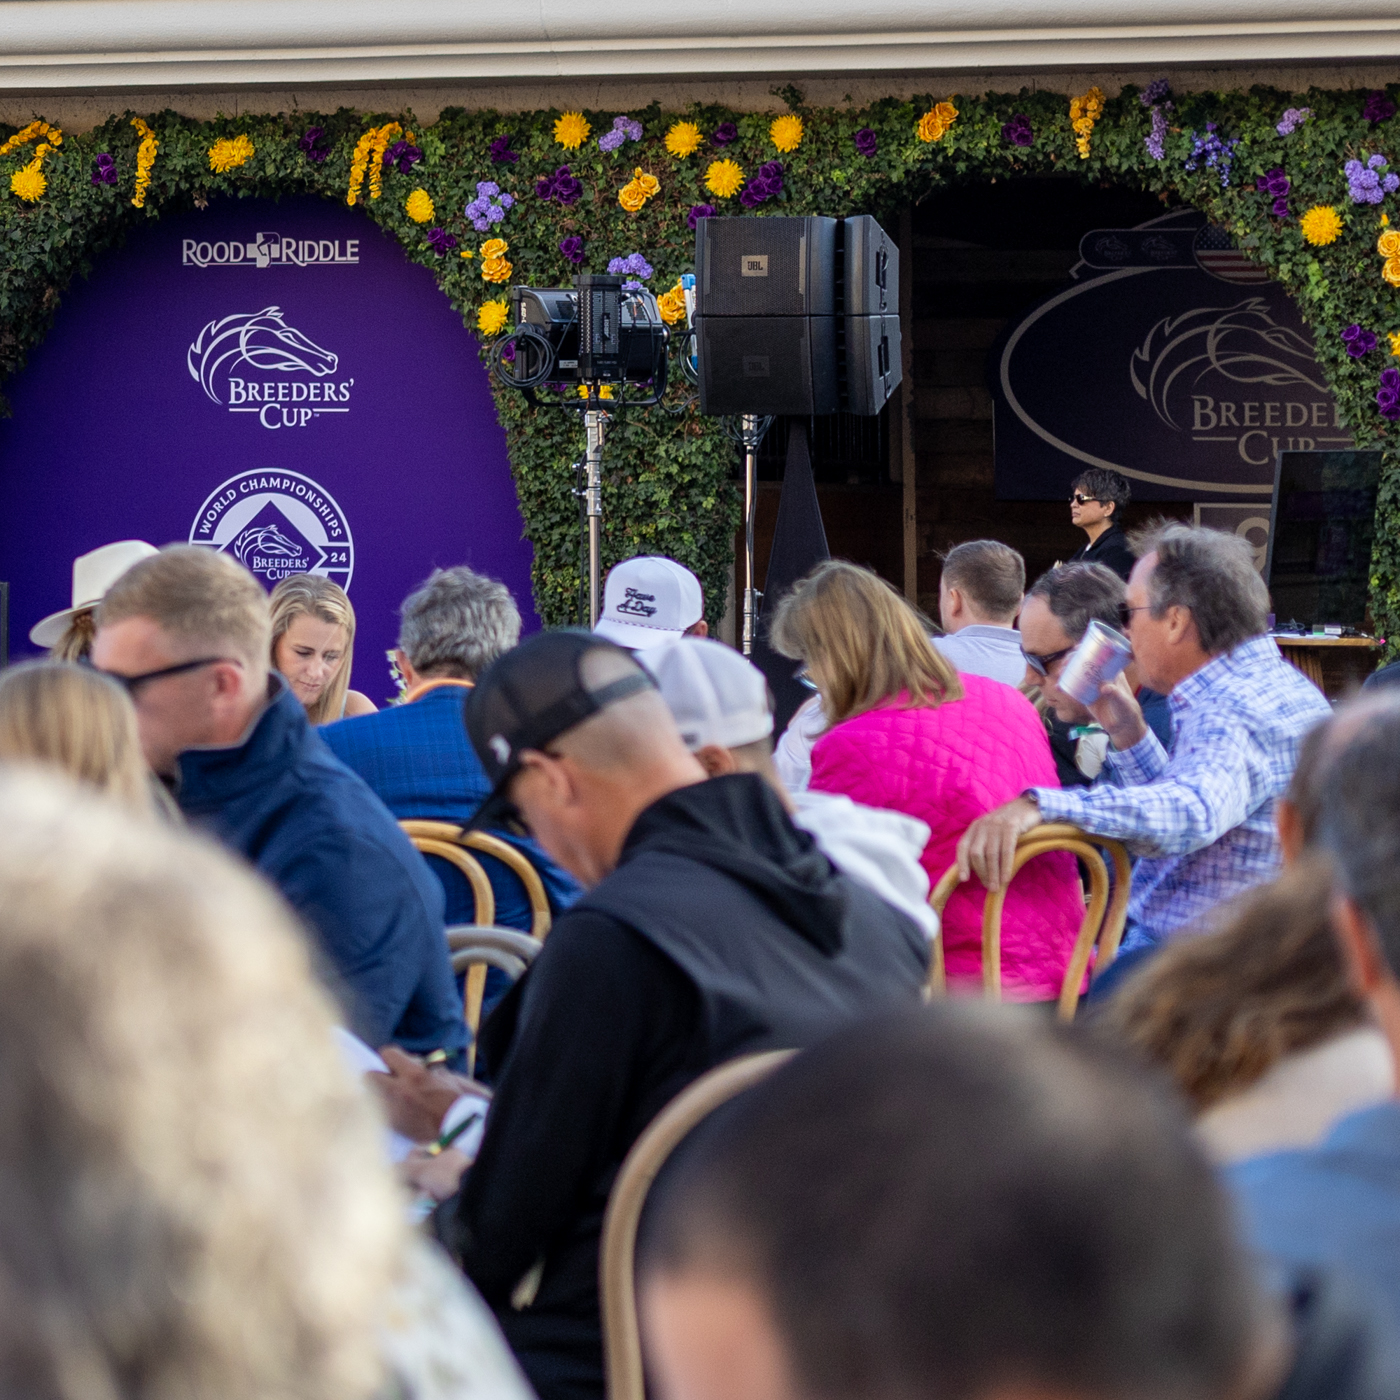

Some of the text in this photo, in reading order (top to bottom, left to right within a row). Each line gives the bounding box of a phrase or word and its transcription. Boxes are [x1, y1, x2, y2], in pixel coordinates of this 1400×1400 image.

[183, 238, 359, 267] ROOD RIDDLE
[748, 261, 763, 271] JBL
[228, 377, 355, 404] BREEDERS'
[259, 403, 313, 429] CUP
[199, 477, 342, 537] WORLD CHAMPIONSHIPS
[253, 556, 309, 568] BREEDERS'
[331, 552, 347, 563] 24
[266, 568, 291, 580] CUP
